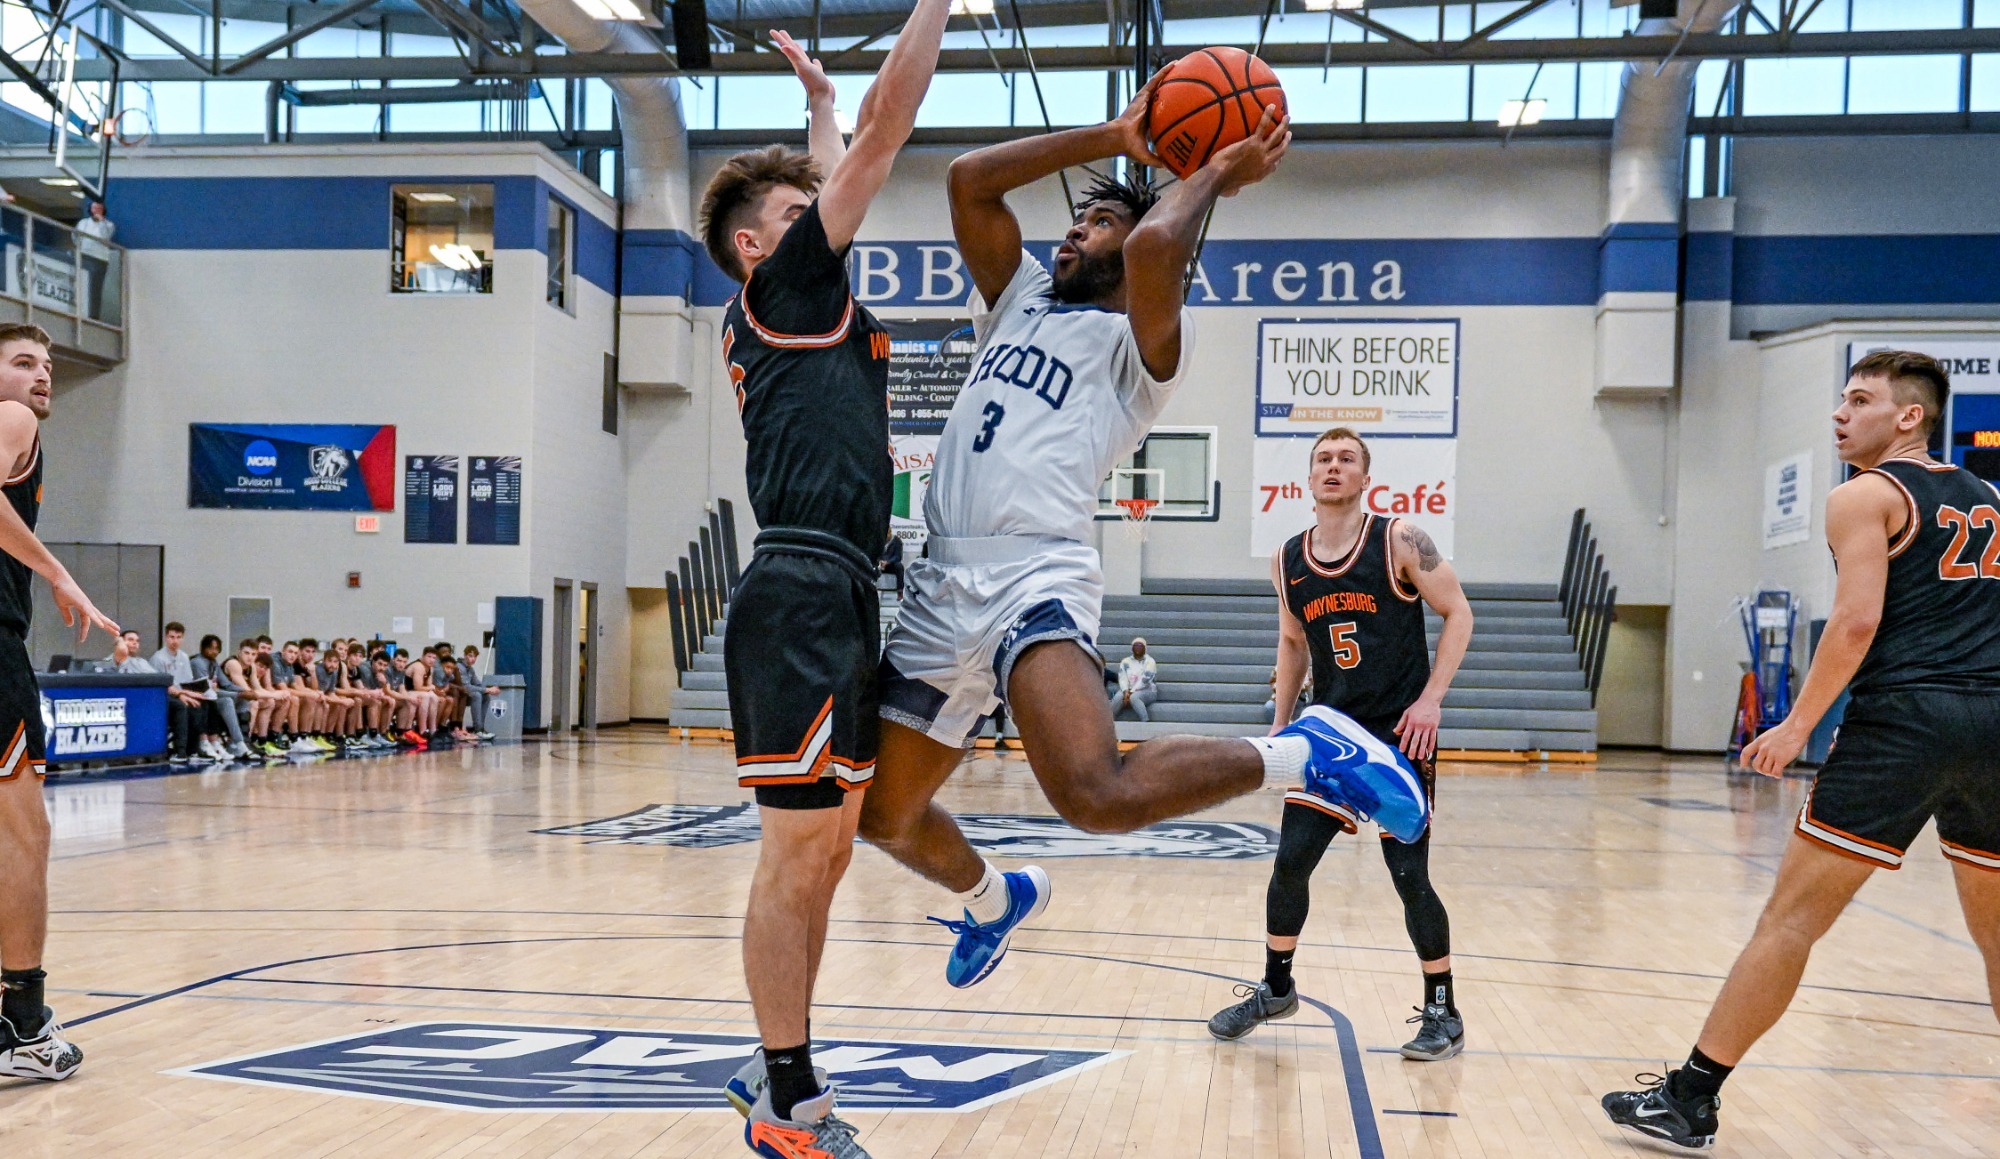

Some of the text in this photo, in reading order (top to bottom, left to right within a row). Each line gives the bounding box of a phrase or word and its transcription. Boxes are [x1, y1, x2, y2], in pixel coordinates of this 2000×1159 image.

[1166, 131, 1199, 168] THE
[1268, 337, 1450, 364] THINK BEFORE
[968, 344, 1073, 410] HOOD
[1287, 369, 1430, 396] YOU DRINK
[889, 394, 923, 402] WELDING
[1262, 405, 1377, 419] STAY IN THE KNOW
[973, 400, 1005, 453] 3
[246, 456, 277, 467] NCAA
[238, 476, 273, 487] Division
[1260, 480, 1447, 514] 7th Café
[358, 517, 377, 530] EXIT
[1936, 504, 2000, 580] 22
[1303, 592, 1377, 623] WAYNESBURG
[1329, 621, 1361, 670] 5
[55, 725, 127, 755] BLAZERS
